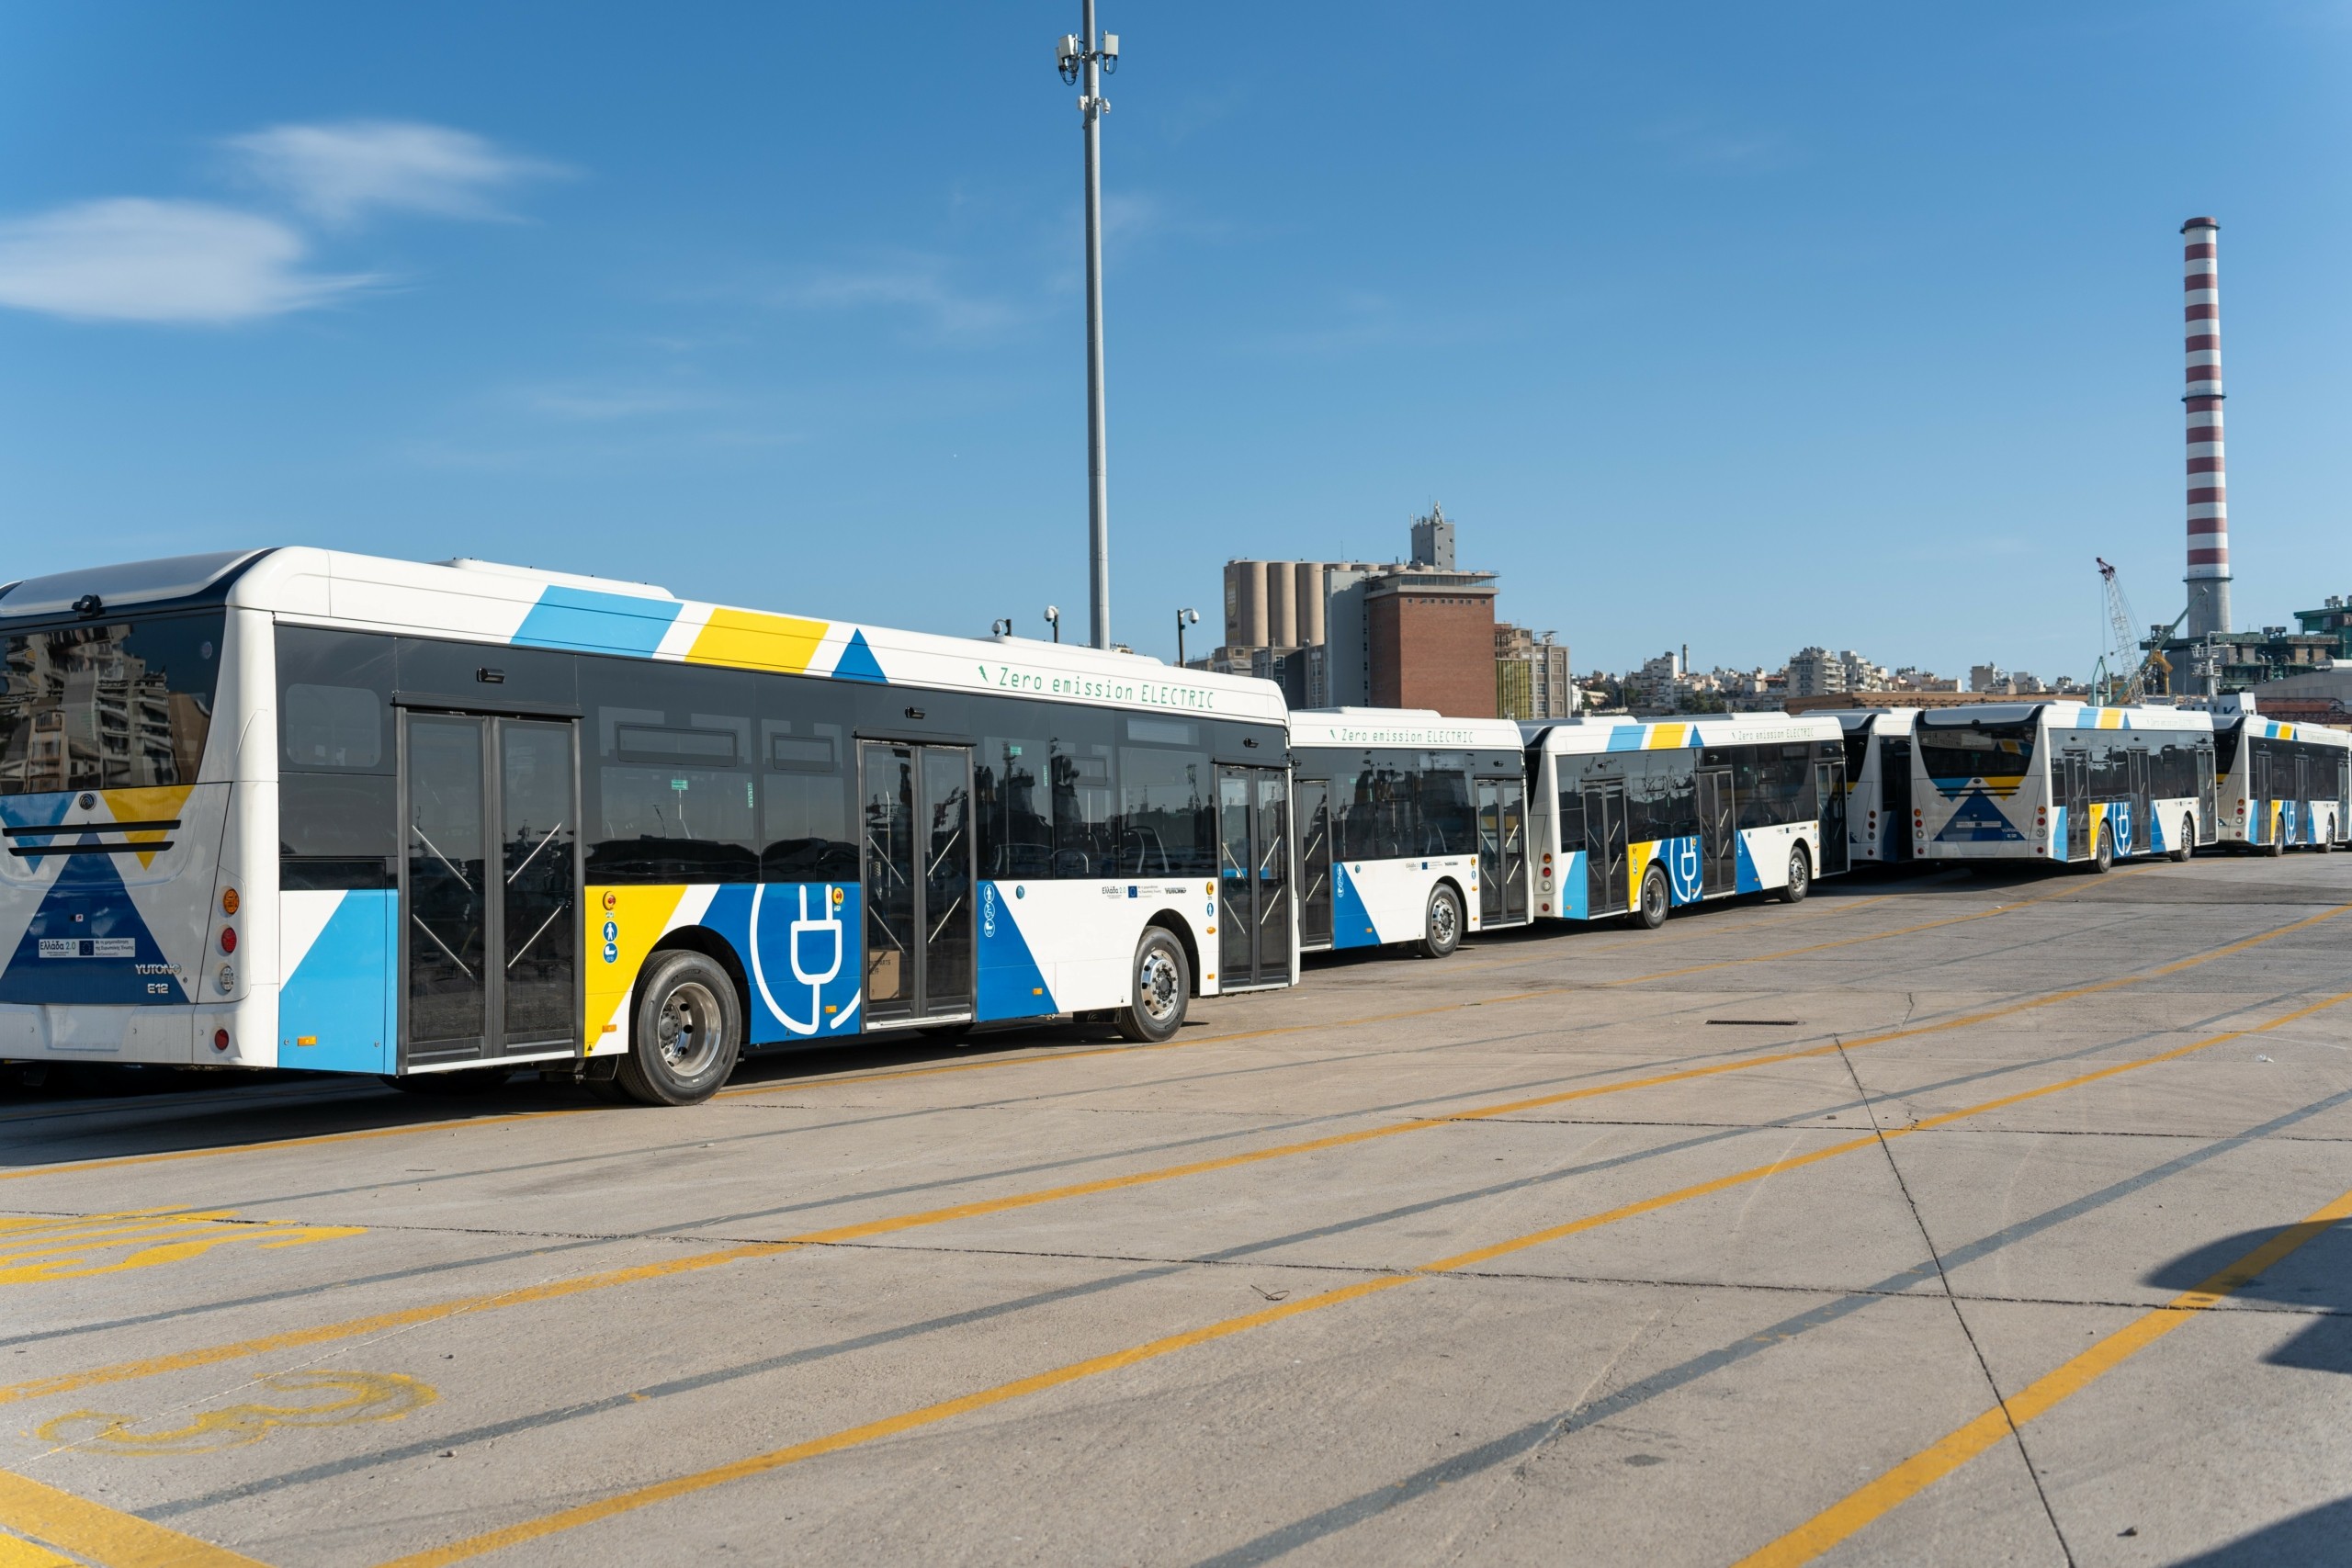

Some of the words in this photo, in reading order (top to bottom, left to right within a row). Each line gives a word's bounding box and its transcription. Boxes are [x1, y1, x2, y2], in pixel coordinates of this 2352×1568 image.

[999, 667, 1042, 690] Zero
[1052, 677, 1133, 701] emission
[1141, 684, 1215, 708] ELECTRIC
[1341, 728, 1367, 742] Zero
[1373, 729, 1422, 742] emission
[1427, 730, 1474, 743] ELECTRIC
[40, 940, 64, 950] Ελλάδα
[65, 941, 76, 950] 2.0
[135, 964, 182, 975] YUTONG
[147, 983, 169, 994] E12
